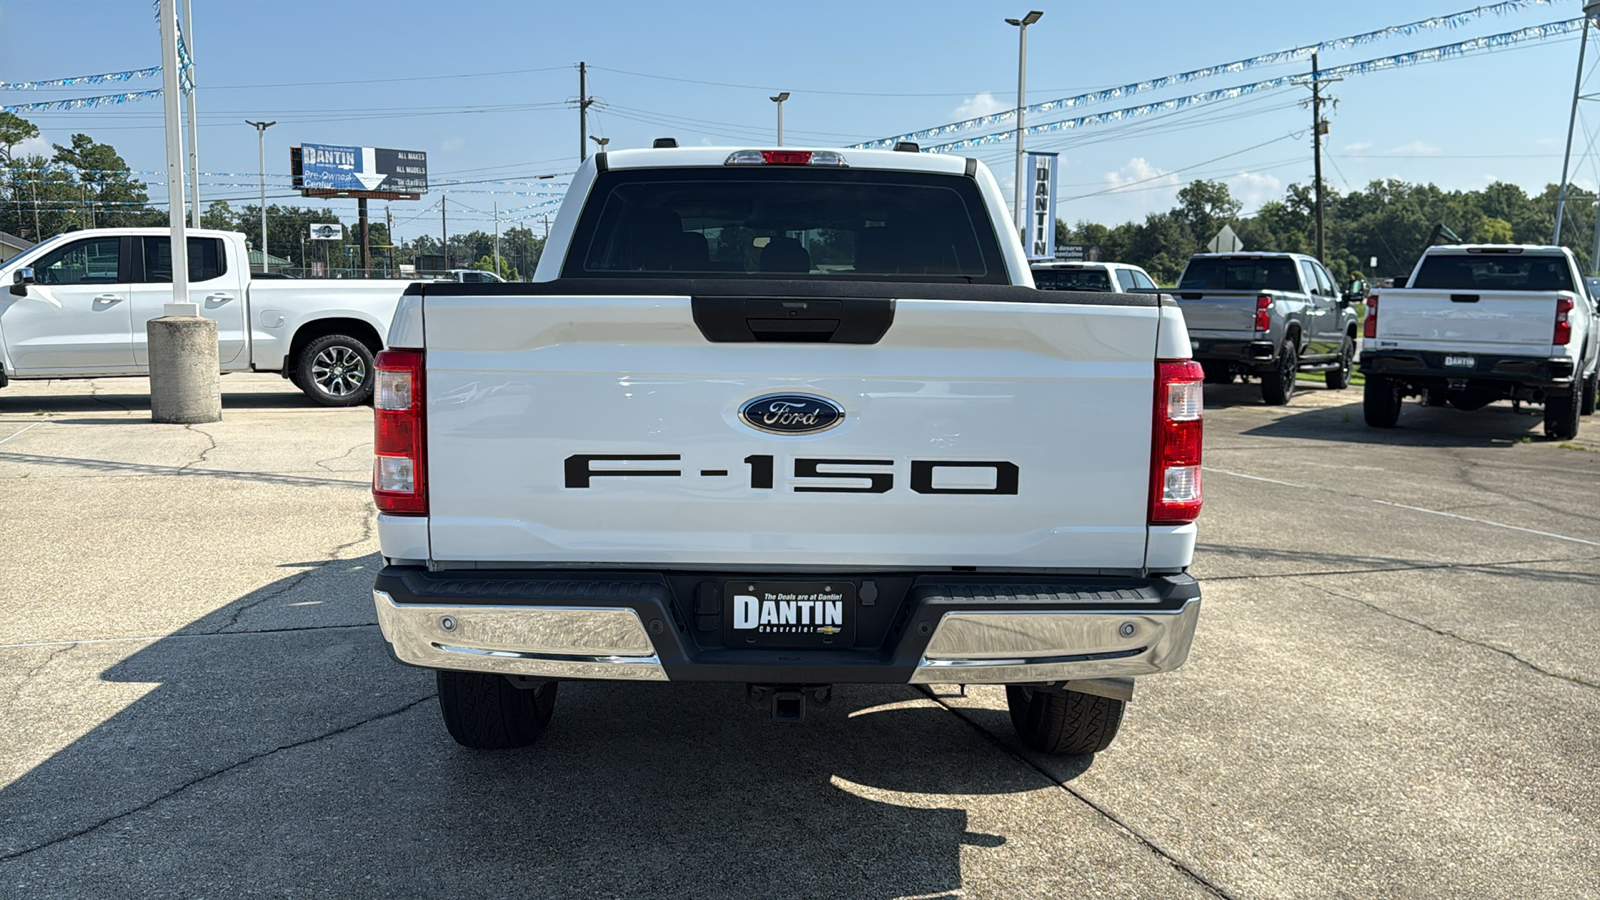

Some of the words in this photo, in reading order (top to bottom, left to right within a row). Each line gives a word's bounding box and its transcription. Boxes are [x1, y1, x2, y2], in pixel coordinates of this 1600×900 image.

[303, 146, 355, 165] DANTIN
[407, 153, 425, 161] MAKES
[304, 170, 352, 181] Pre-Owned
[396, 165, 405, 173] ALL
[405, 166, 426, 174] MODELS
[1034, 168, 1049, 255] DANTIN
[763, 401, 820, 425] Ford
[564, 454, 1019, 495] F-150
[733, 595, 843, 629] DANTIN
[758, 625, 814, 633] Chevrolet
